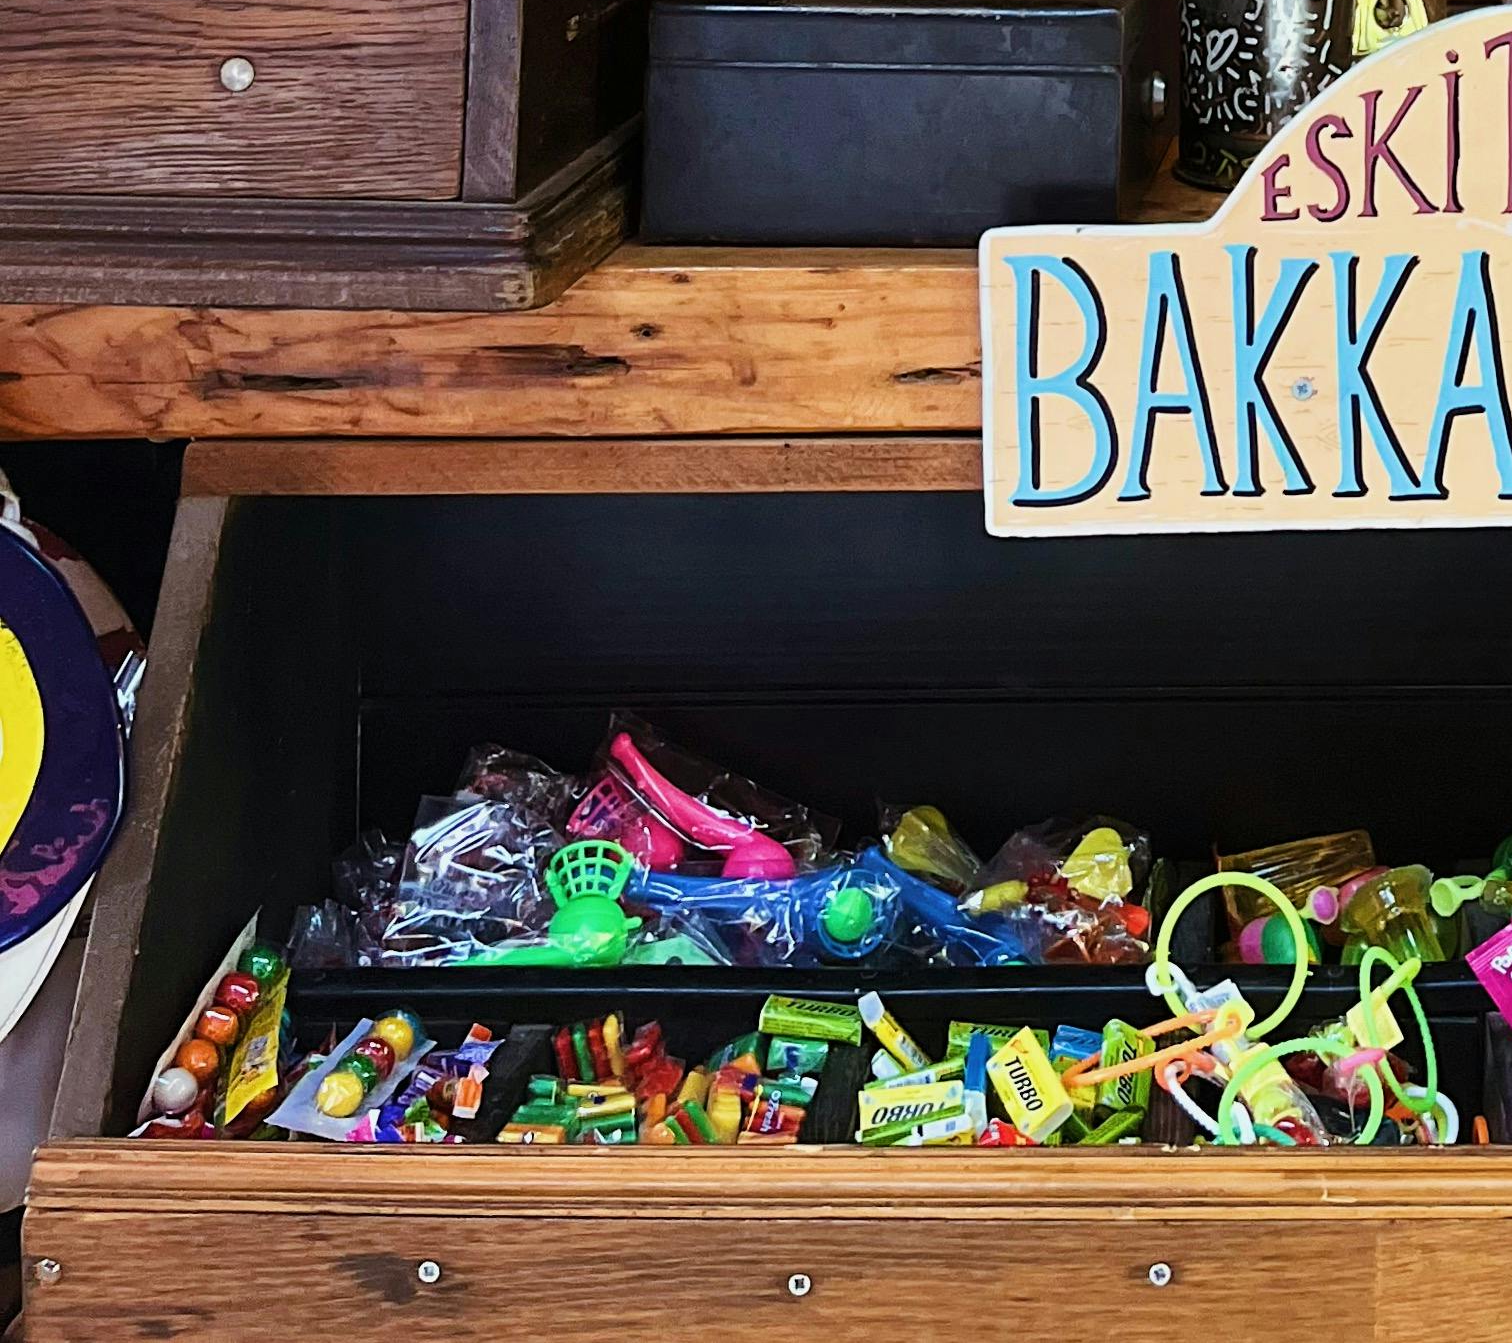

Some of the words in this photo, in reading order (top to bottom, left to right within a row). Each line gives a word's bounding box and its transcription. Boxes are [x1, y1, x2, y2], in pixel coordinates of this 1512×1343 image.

[1259, 50, 1461, 223] ESKİ
[786, 1000, 857, 1018] TURBO
[1004, 1055, 1045, 1113] TURBO
